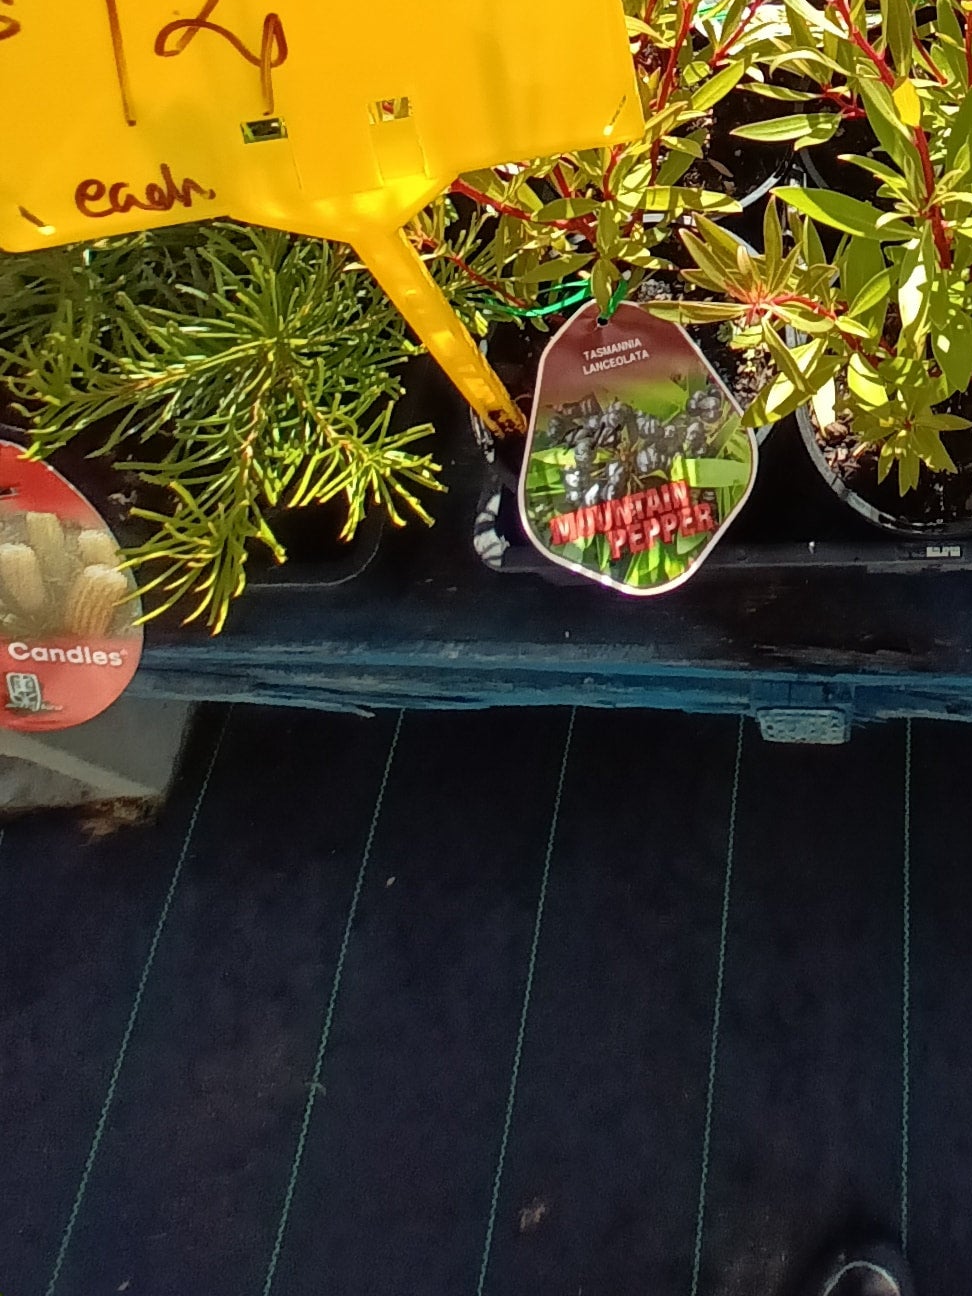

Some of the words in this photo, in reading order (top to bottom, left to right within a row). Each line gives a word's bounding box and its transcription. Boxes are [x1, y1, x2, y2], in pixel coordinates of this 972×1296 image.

[74, 163, 216, 218] each
[582, 337, 643, 361] TASMANNIA
[582, 349, 651, 376] LANCEOLATA
[549, 480, 692, 546] MOUNTAIN
[607, 503, 715, 560] PEPPER
[7, 641, 124, 667] Candles
